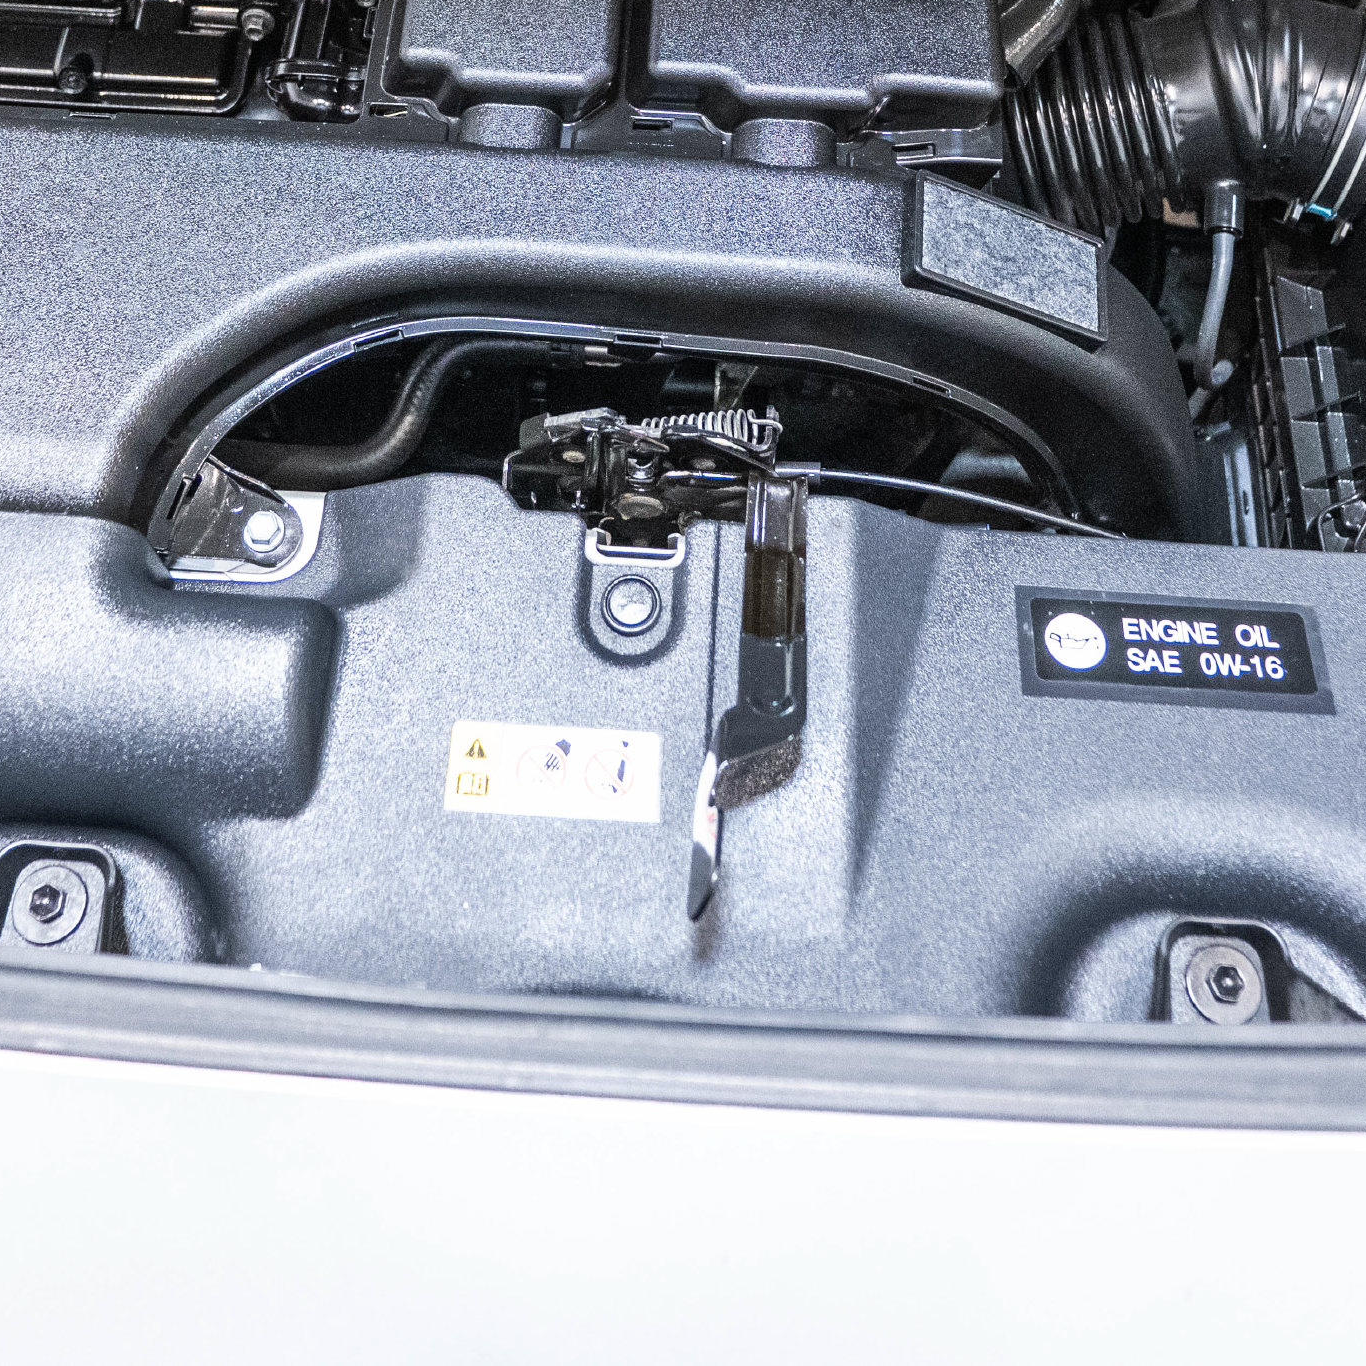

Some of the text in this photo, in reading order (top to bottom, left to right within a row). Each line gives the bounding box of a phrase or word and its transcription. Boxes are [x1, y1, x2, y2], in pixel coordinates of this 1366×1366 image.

[1121, 617, 1281, 650] ENGINE OIL
[1126, 648, 1285, 680] SAE 0W-16
